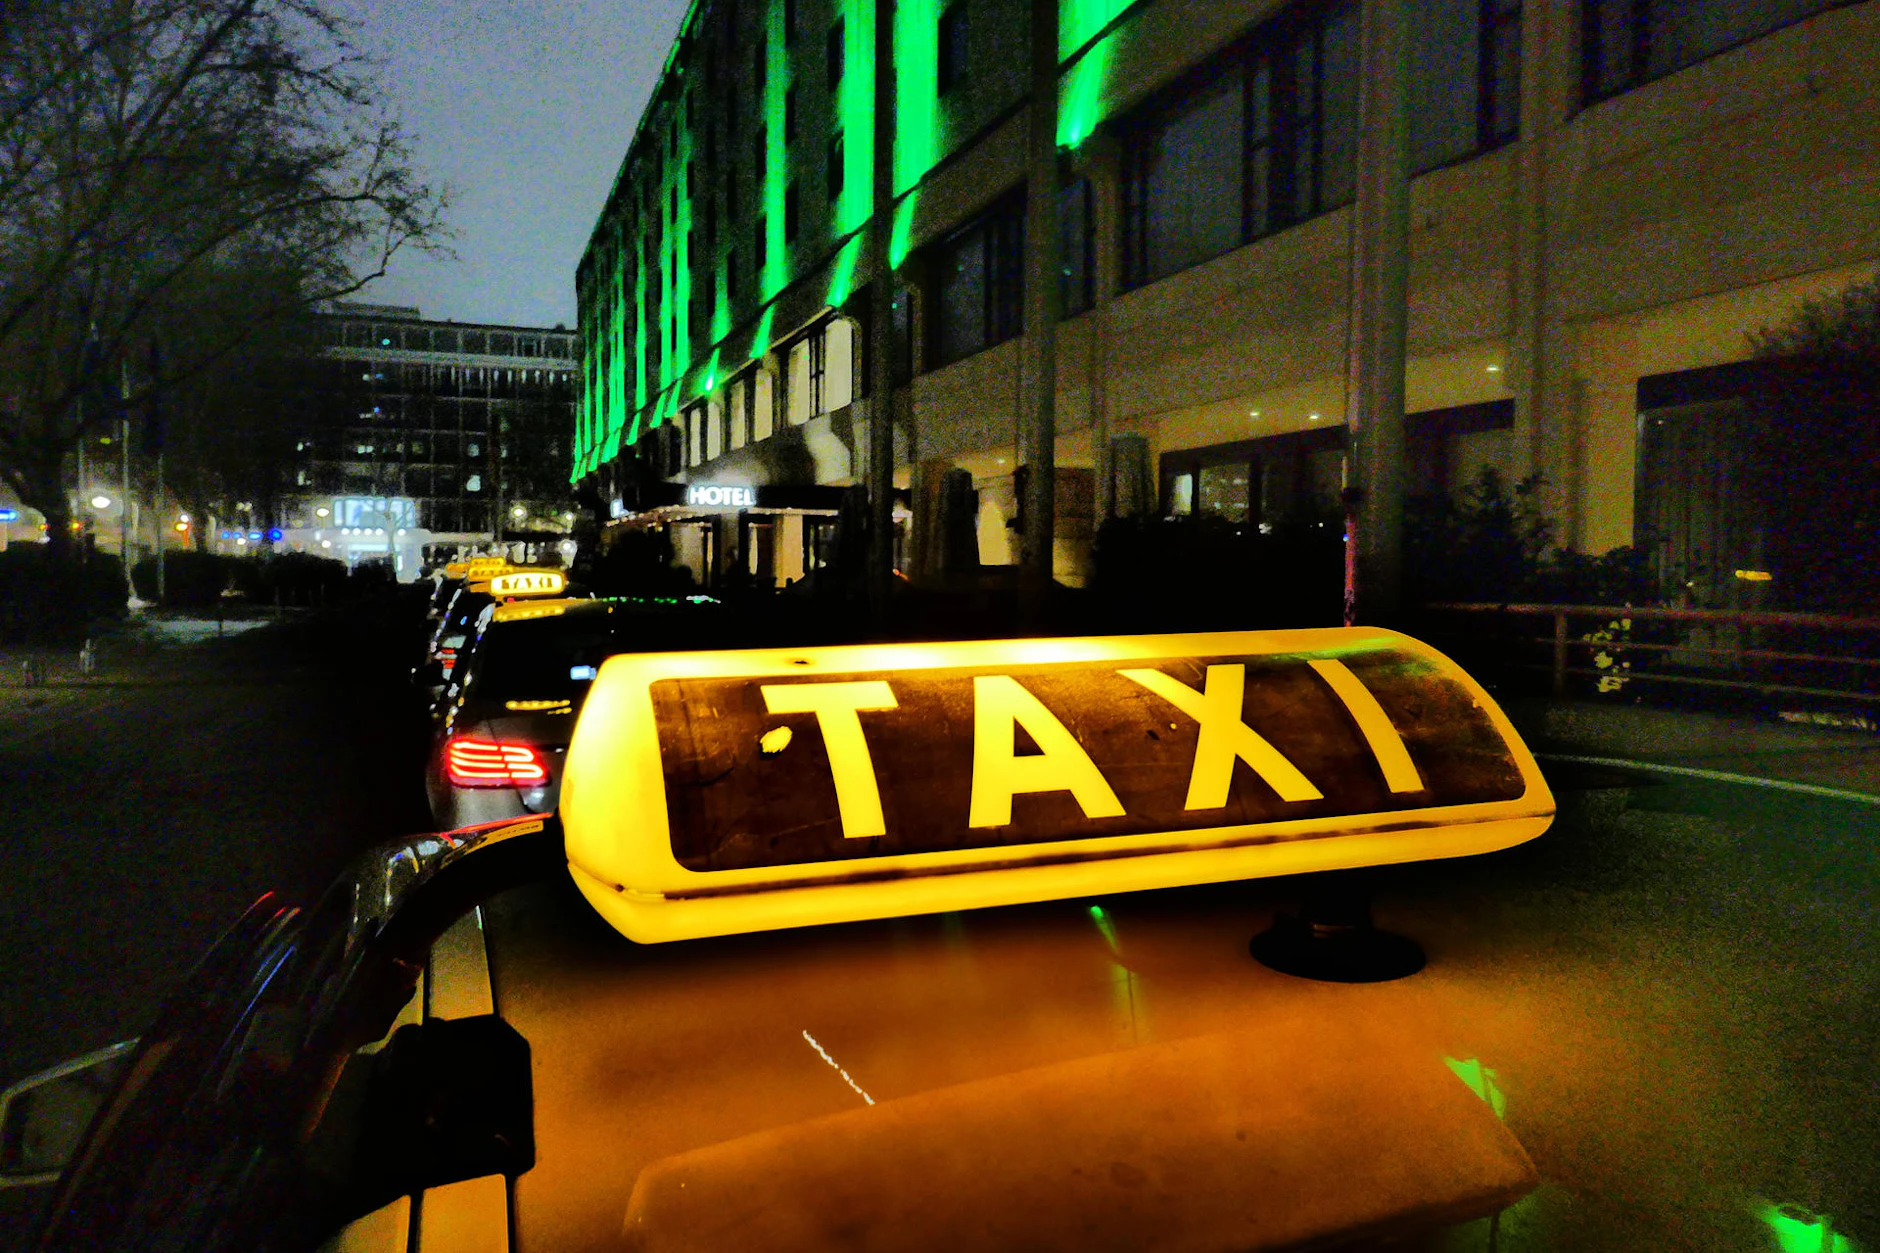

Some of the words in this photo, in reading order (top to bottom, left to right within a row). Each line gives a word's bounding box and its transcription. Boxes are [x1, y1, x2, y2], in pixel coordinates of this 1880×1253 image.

[689, 486, 755, 506] HOTEL
[501, 577, 553, 590] TAXI
[762, 659, 1426, 839] TAXI
